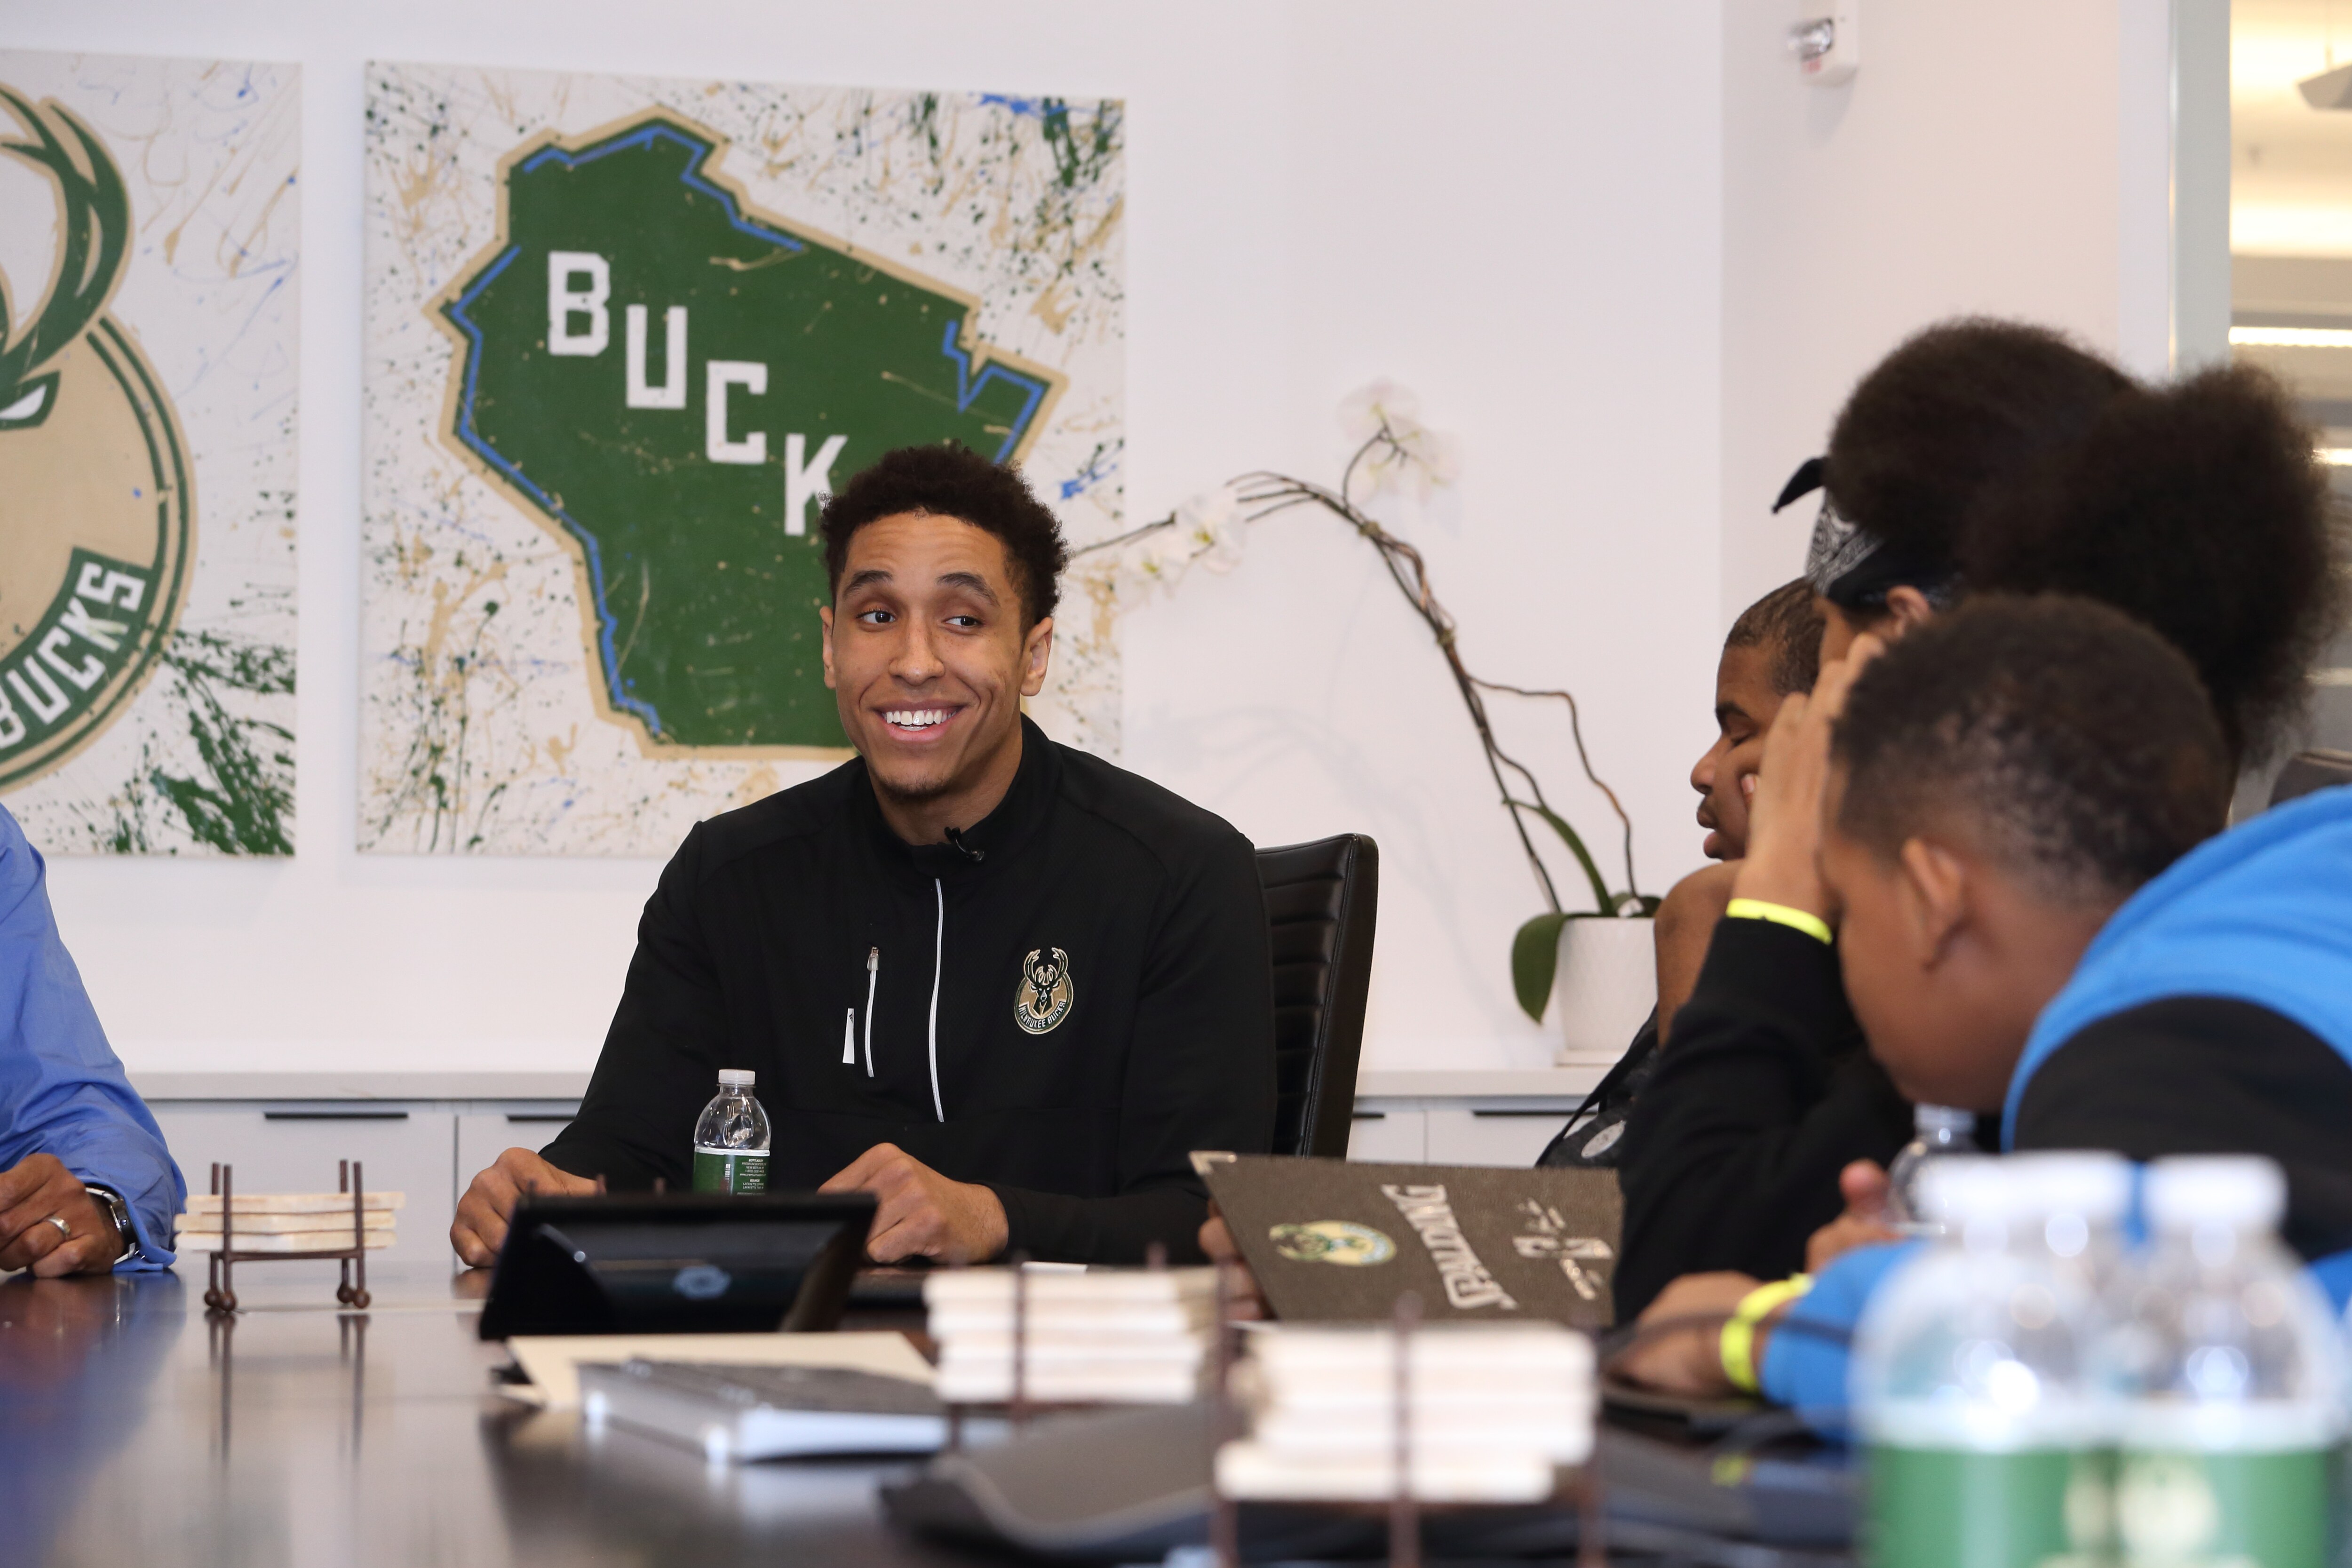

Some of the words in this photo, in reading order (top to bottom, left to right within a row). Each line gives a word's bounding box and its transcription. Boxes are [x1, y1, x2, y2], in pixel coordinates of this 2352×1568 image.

[0, 561, 146, 749] BUCKS
[1018, 1006, 1046, 1028] MILWAUKEE
[1048, 1002, 1065, 1024] BUCKS
[1380, 1183, 1519, 1311] SPALDING
